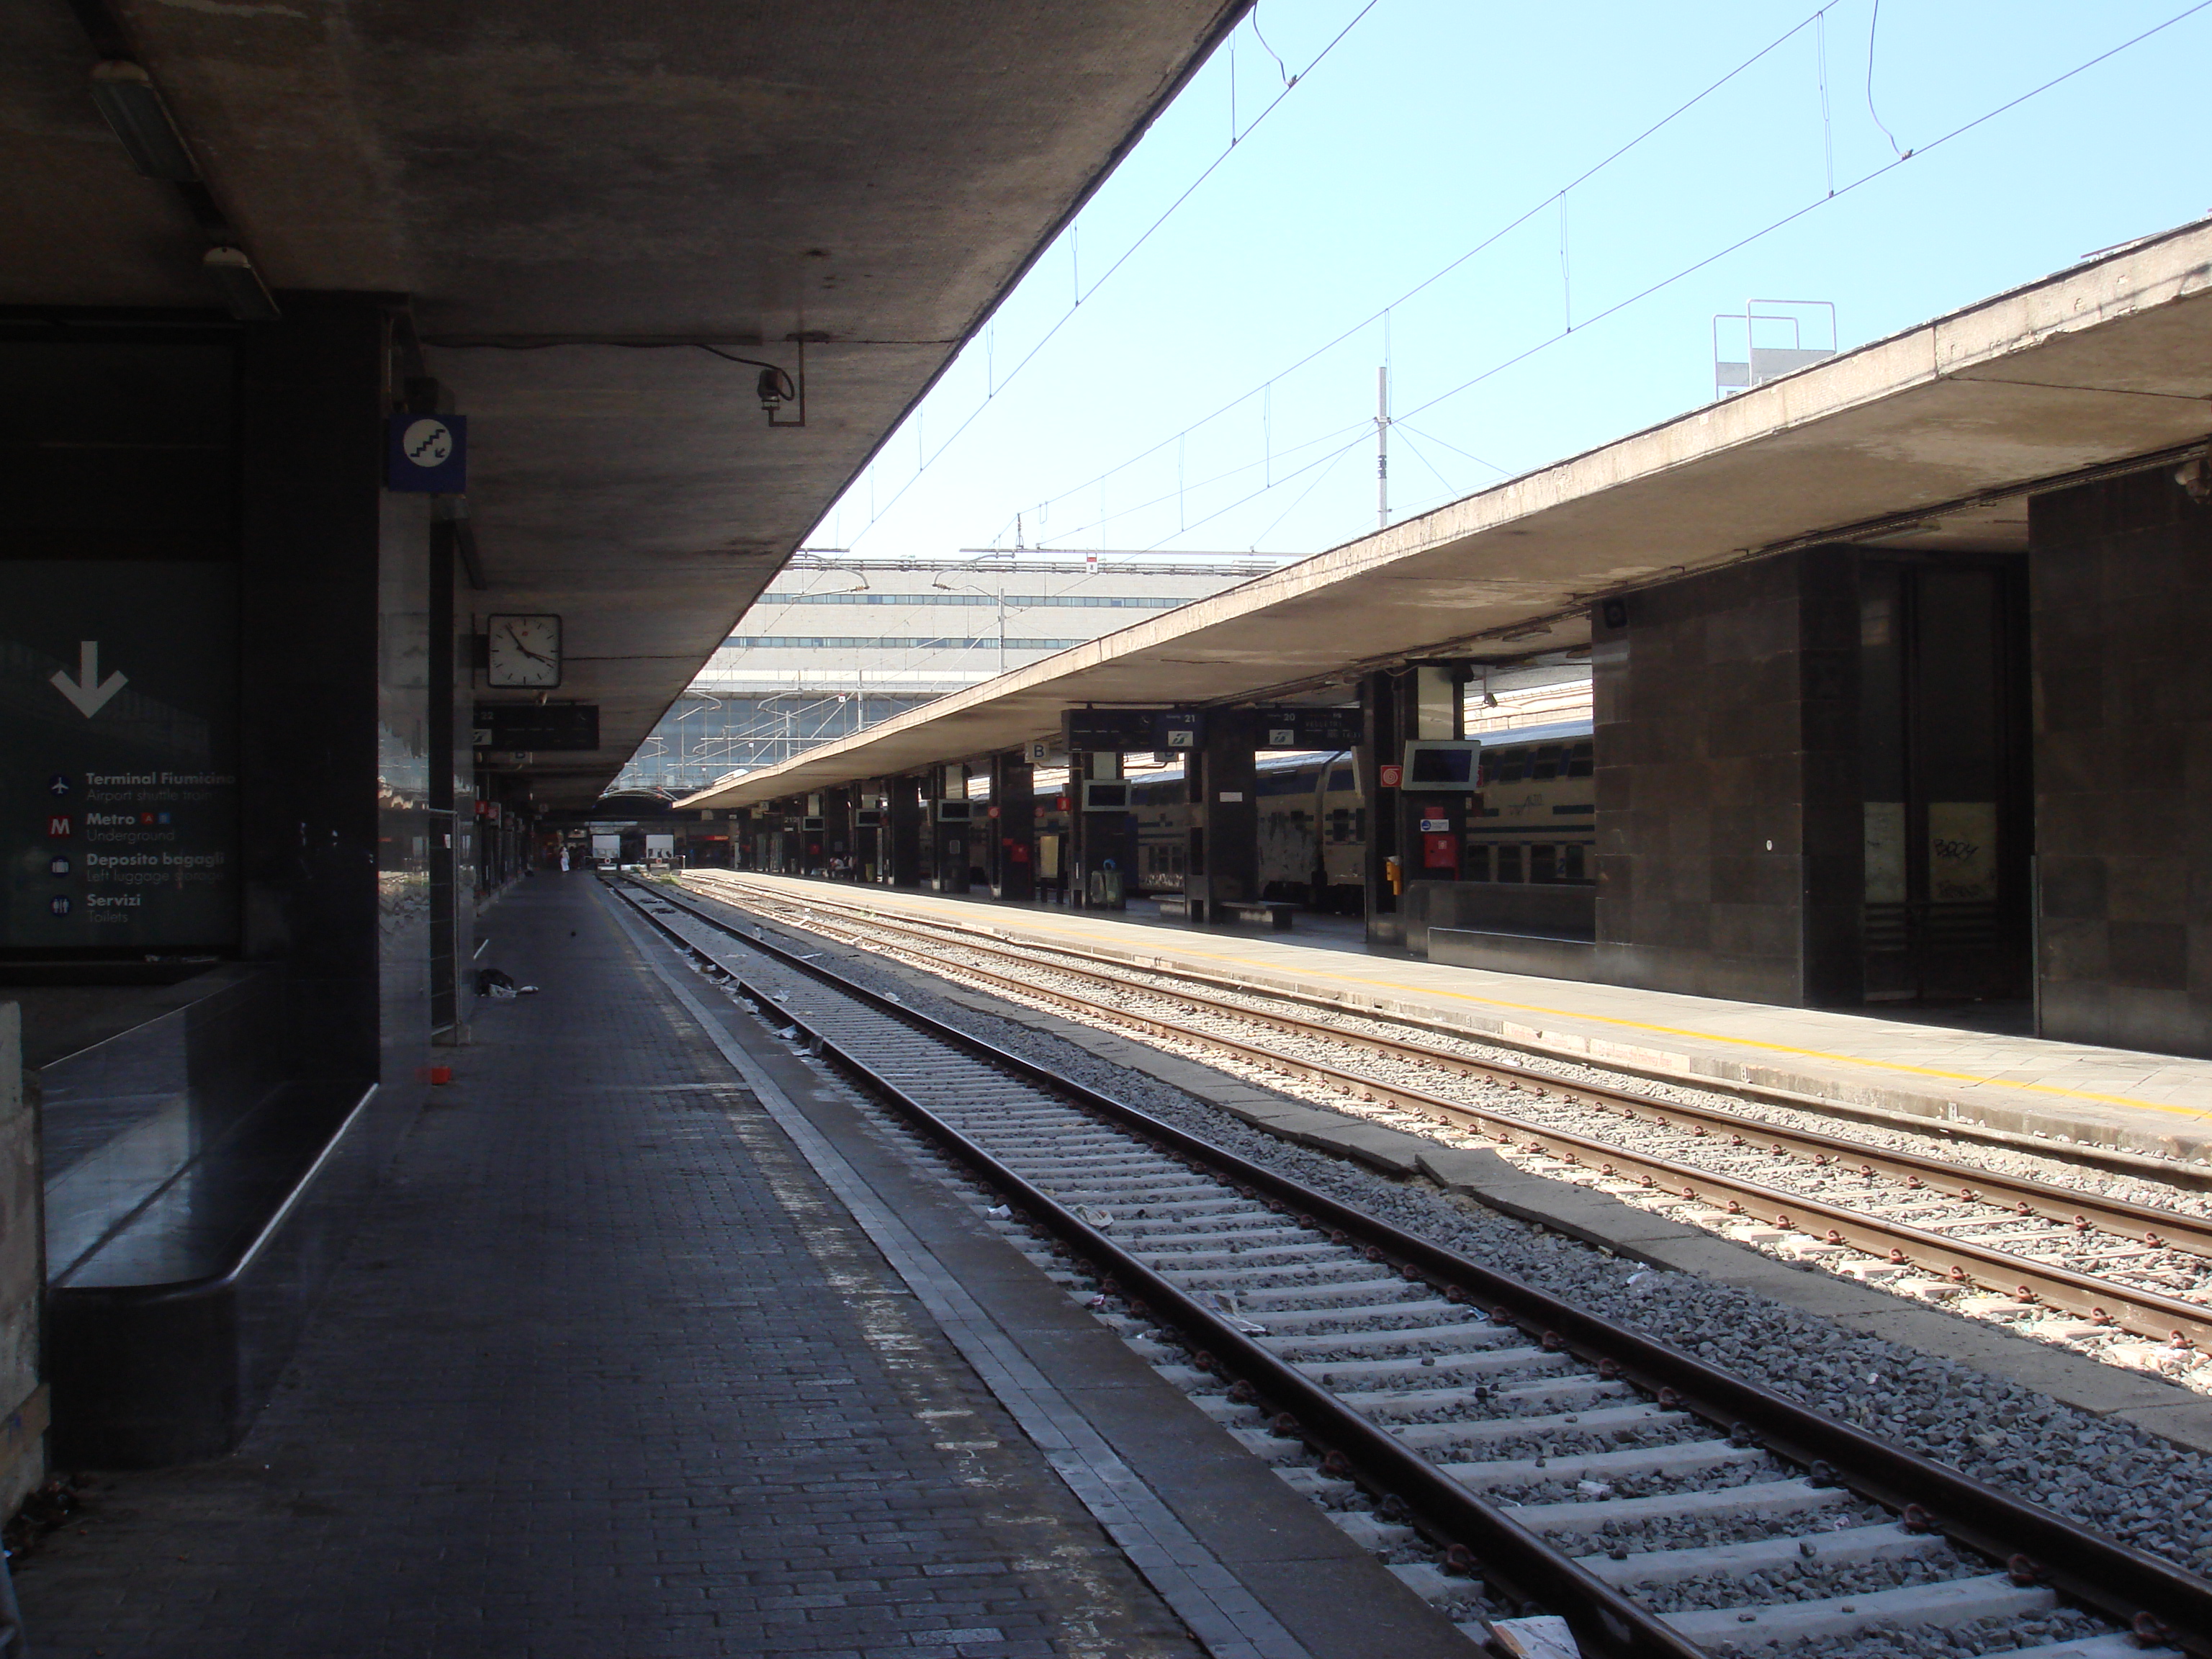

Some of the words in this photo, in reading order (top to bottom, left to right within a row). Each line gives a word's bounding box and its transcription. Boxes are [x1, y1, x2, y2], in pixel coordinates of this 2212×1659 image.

[480, 711, 494, 720] 22
[1184, 714, 1195, 723] 21
[1033, 745, 1045, 758] B
[86, 772, 156, 785] Terminal
[161, 772, 236, 785] Fiumicino
[86, 790, 132, 804] Airport
[137, 789, 179, 801] shuttle
[183, 790, 212, 801] train
[86, 813, 135, 826] Metro
[50, 819, 71, 835] M
[86, 830, 175, 844] Underground
[86, 853, 158, 868] Deposito
[163, 853, 225, 868] bagagli
[1557, 858, 1565, 874] 2
[87, 869, 109, 881] Left
[114, 867, 169, 885] luggage
[174, 869, 224, 884] storage
[86, 894, 141, 907] Servizi
[87, 910, 128, 923] Toilets
